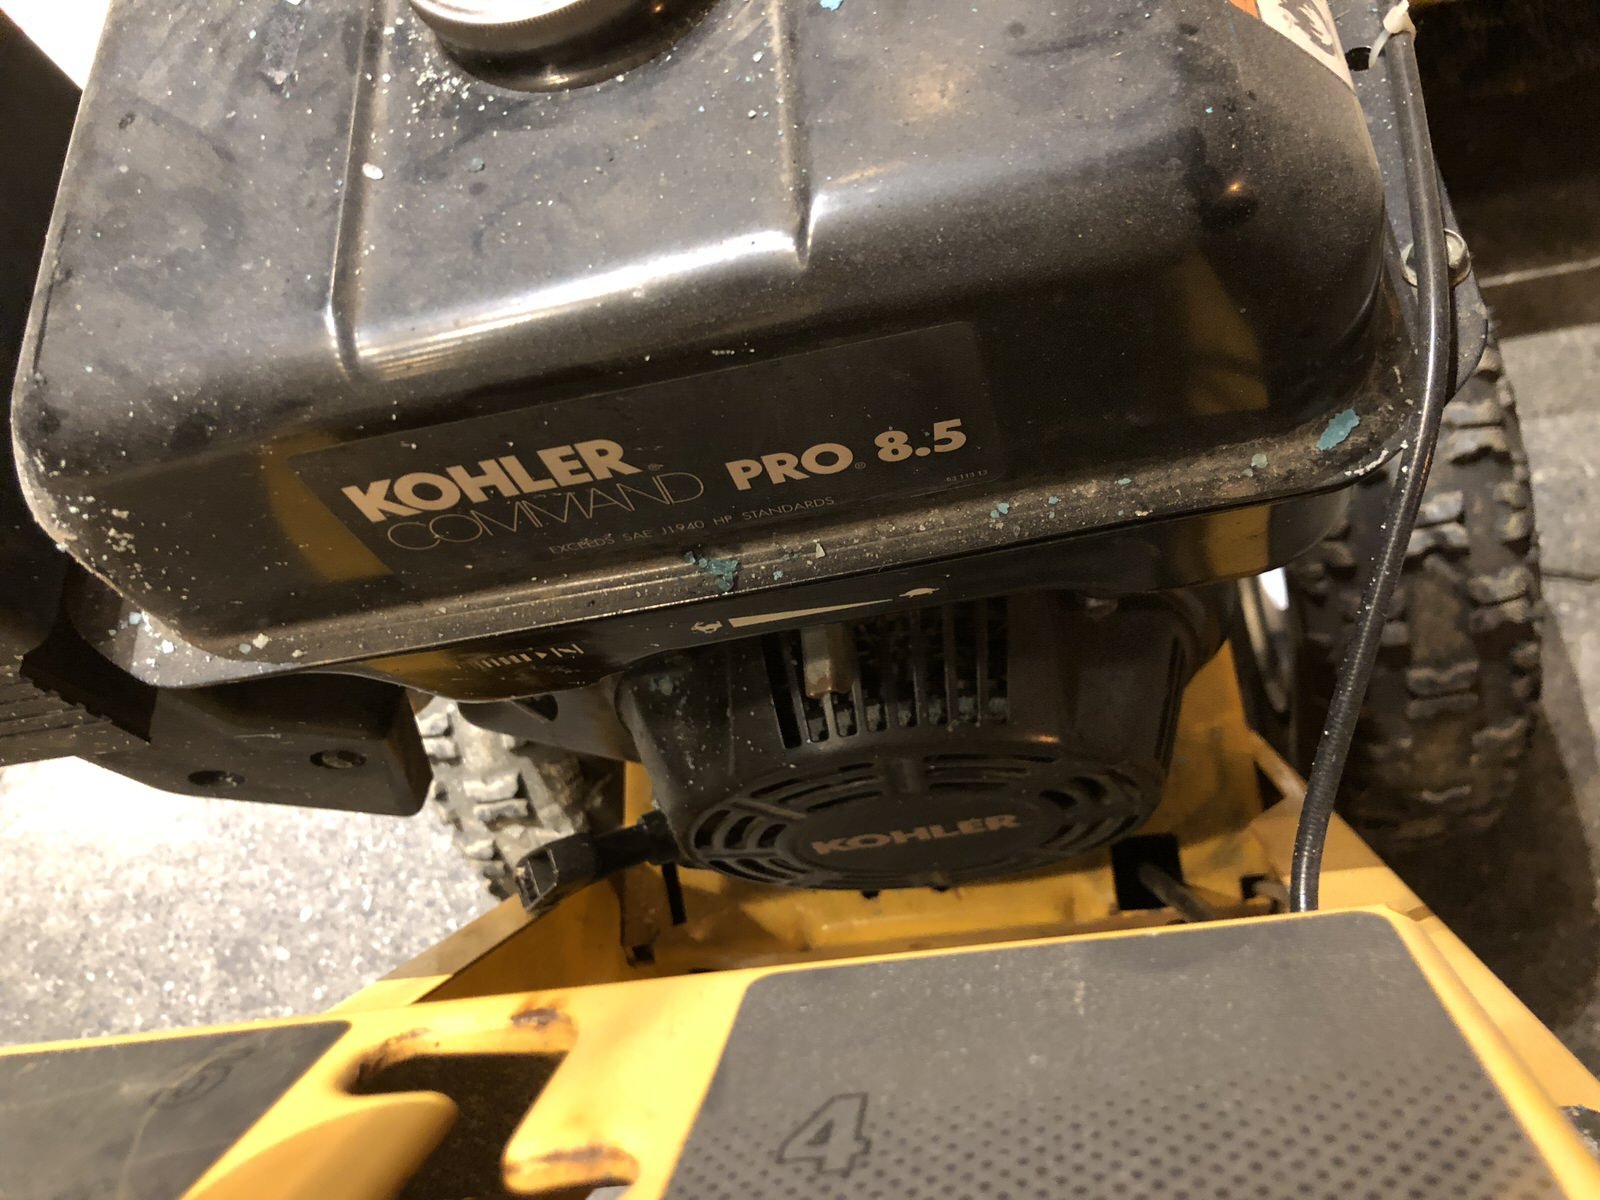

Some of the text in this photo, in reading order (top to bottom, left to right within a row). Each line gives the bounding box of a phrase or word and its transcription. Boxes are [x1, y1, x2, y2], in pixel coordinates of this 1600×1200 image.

[341, 438, 644, 523] KOHLER
[386, 418, 968, 550] COMMAND PRO 8.5
[548, 496, 835, 554] EXCEEDS SAE J1940 HP STANDARDS
[810, 813, 1023, 856] KOHLER
[775, 1091, 872, 1179] 4
